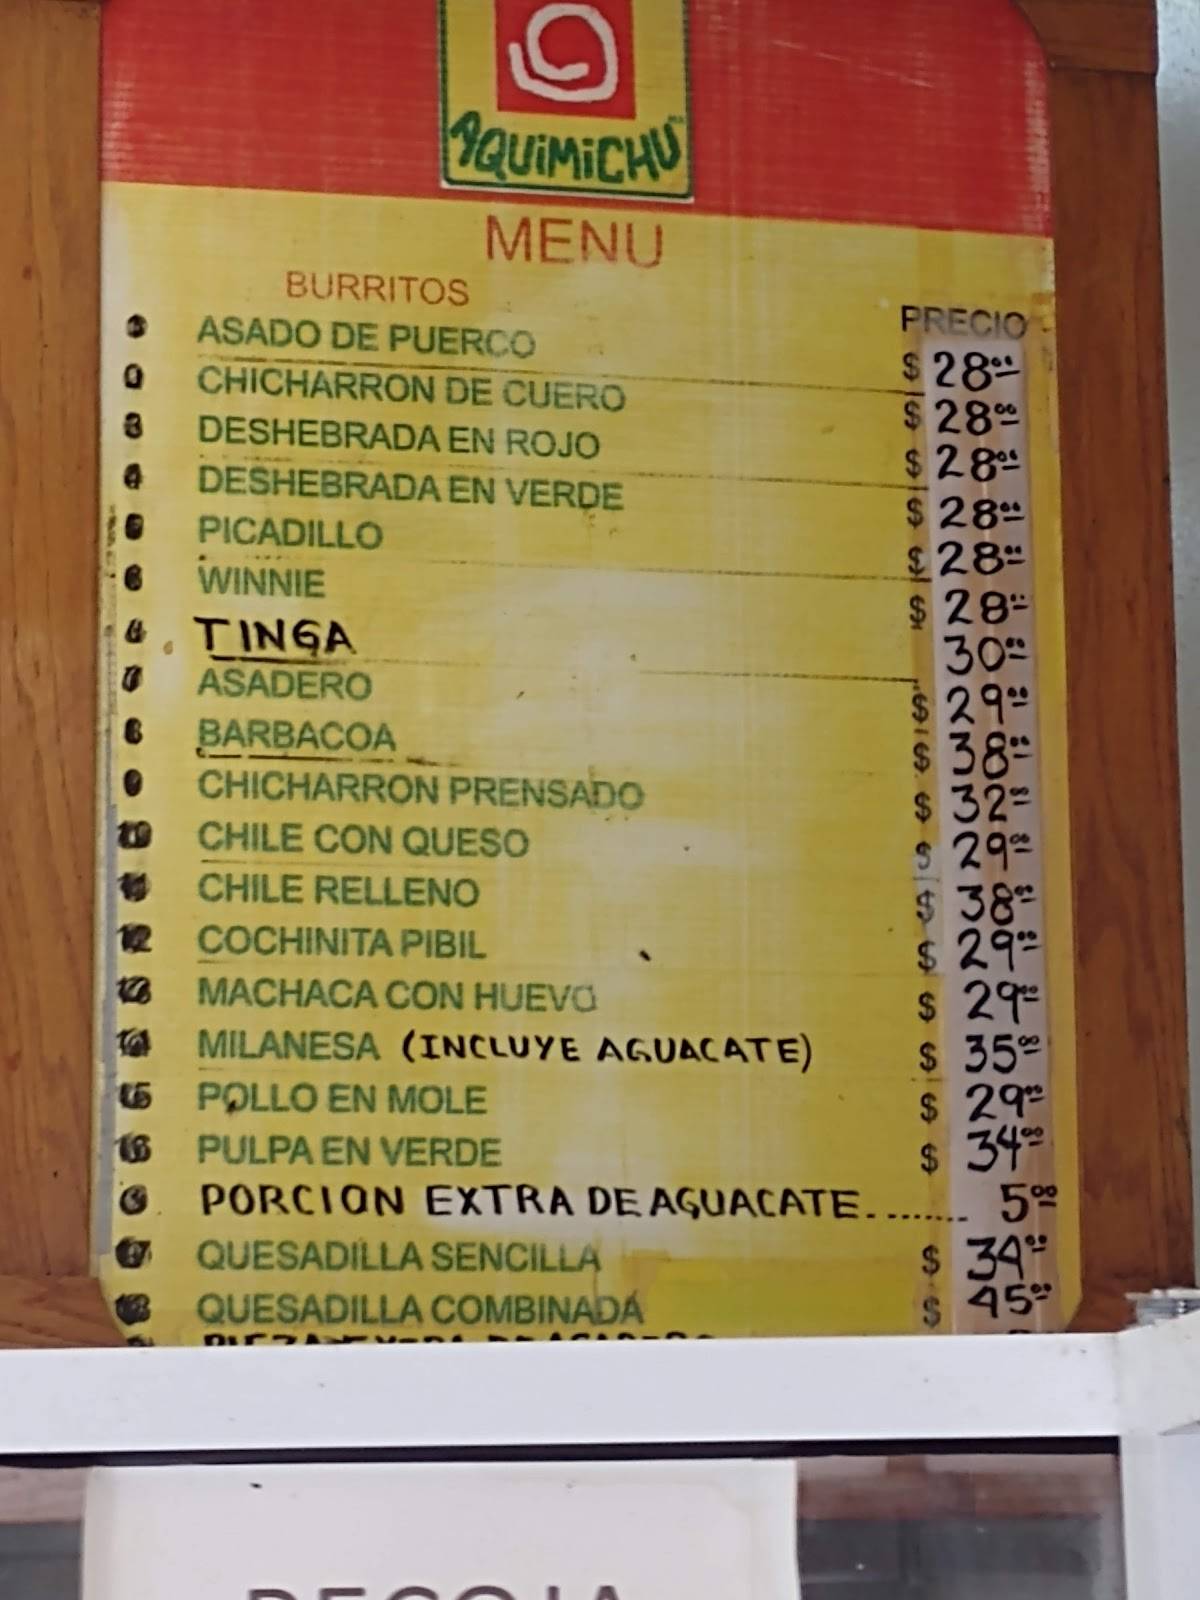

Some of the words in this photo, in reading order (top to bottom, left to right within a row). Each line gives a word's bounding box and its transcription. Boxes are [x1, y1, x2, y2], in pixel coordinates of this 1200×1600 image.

[487, 214, 663, 268] MENU
[286, 270, 470, 307] BURRITOS
[197, 316, 321, 349] ASADO
[332, 322, 378, 352] DE
[389, 323, 536, 359] PUERCO
[901, 305, 1028, 340] PRECIO
[198, 366, 434, 403] CHICHARRON
[447, 376, 492, 406] DE
[503, 379, 626, 413] CUERO
[200, 416, 439, 451] DESHEBRADA
[449, 427, 494, 454] EN
[507, 429, 600, 460] ROJO
[200, 465, 440, 502] DESHEBRADA
[450, 477, 495, 504] EN
[506, 479, 624, 511] VERDE
[199, 516, 383, 550] PICADILLO
[198, 567, 326, 599] WINNIE
[193, 616, 355, 655] TINGA
[197, 668, 372, 702] ASADERO
[198, 719, 396, 752] BARBACOA
[198, 770, 439, 806] CHICHARRON
[449, 777, 644, 812] PRENSADO
[198, 822, 302, 852] CHILE
[314, 824, 392, 855] CON
[403, 826, 530, 860] QUESO
[198, 873, 302, 904] CHILE
[314, 875, 479, 909] RELLENO
[198, 923, 393, 957] COCHINITA
[401, 929, 486, 959] PIBIL
[198, 977, 379, 1010] MACHACA
[385, 981, 465, 1011] CON
[474, 983, 597, 1014] HUEVO
[198, 1030, 380, 1060] MILANESA
[401, 1029, 580, 1065] (INCLUYE
[597, 1033, 812, 1073] AGUACATE)
[197, 1082, 317, 1113] POLLO
[328, 1084, 377, 1114] EN
[388, 1086, 487, 1115] MOLE
[197, 1136, 313, 1165] PULPA
[322, 1137, 370, 1166] EN
[380, 1137, 502, 1168] VERDE
[201, 1184, 405, 1217] PORCION
[426, 1184, 575, 1217] EXTRA
[589, 1186, 642, 1218] DE
[197, 1240, 420, 1272] QUESADILLA
[432, 1242, 601, 1273] SENCILLA
[197, 1293, 424, 1326] QUESADILLA
[430, 1295, 644, 1327] COMBINADA
